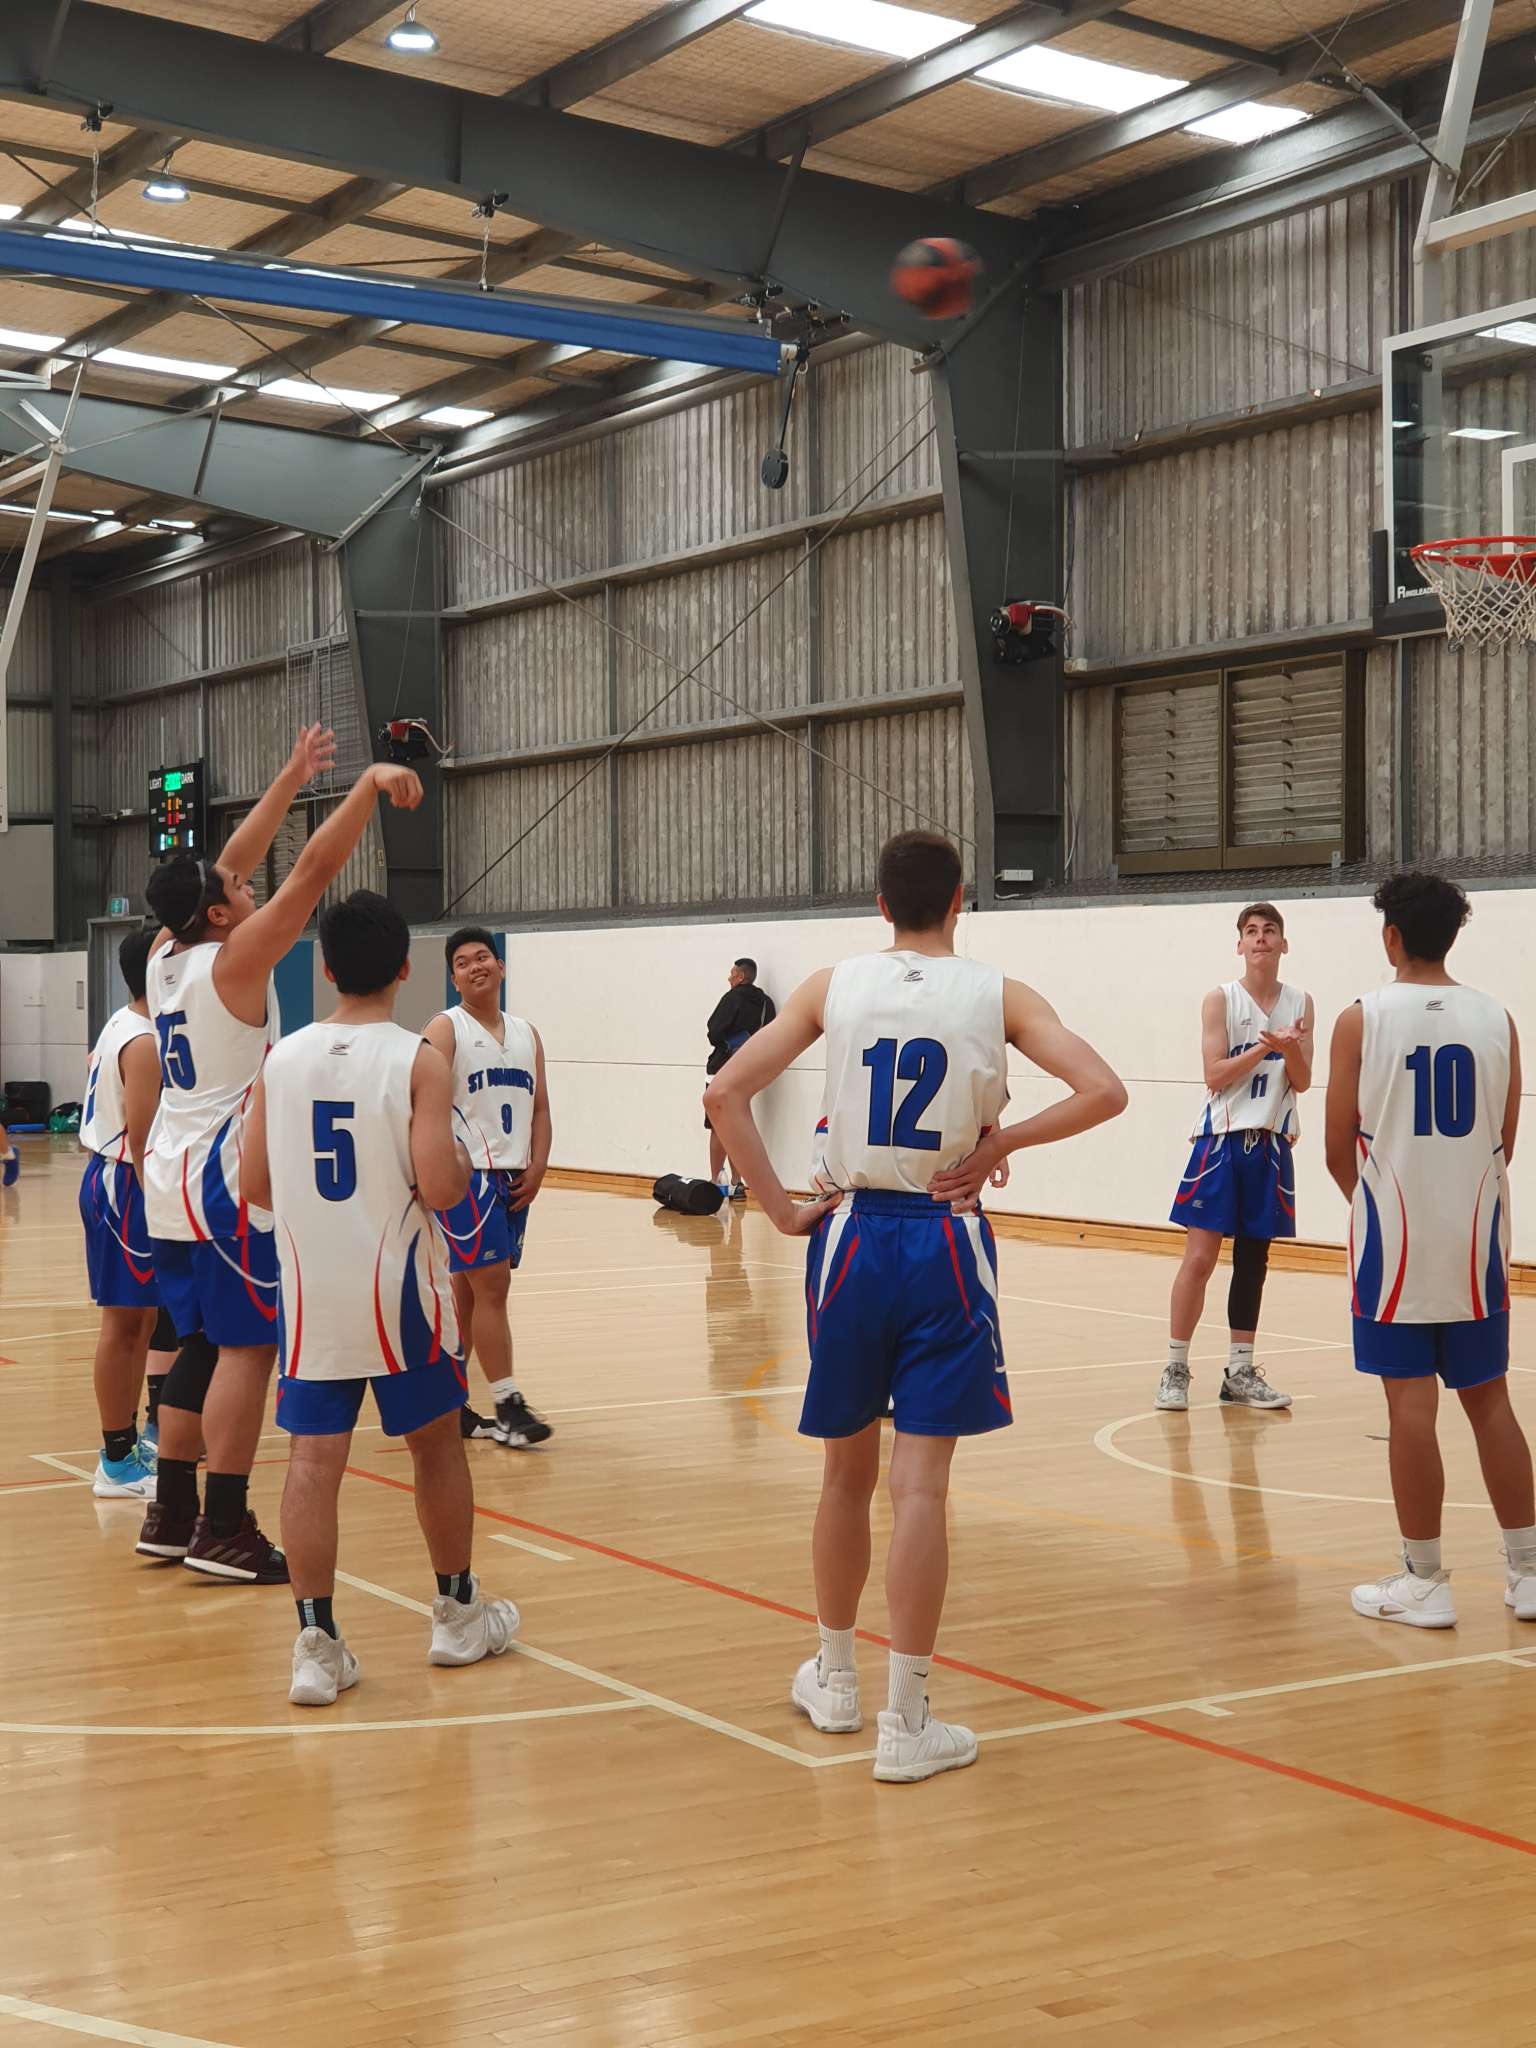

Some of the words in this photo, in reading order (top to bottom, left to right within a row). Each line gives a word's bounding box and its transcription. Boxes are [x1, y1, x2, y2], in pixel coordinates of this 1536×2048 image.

[155, 1010, 197, 1090] 15
[1250, 1073, 1269, 1099] 11
[1405, 1043, 1477, 1138] 10
[501, 1103, 513, 1135] 9
[862, 1037, 949, 1152] 12
[312, 1100, 357, 1202] 5
